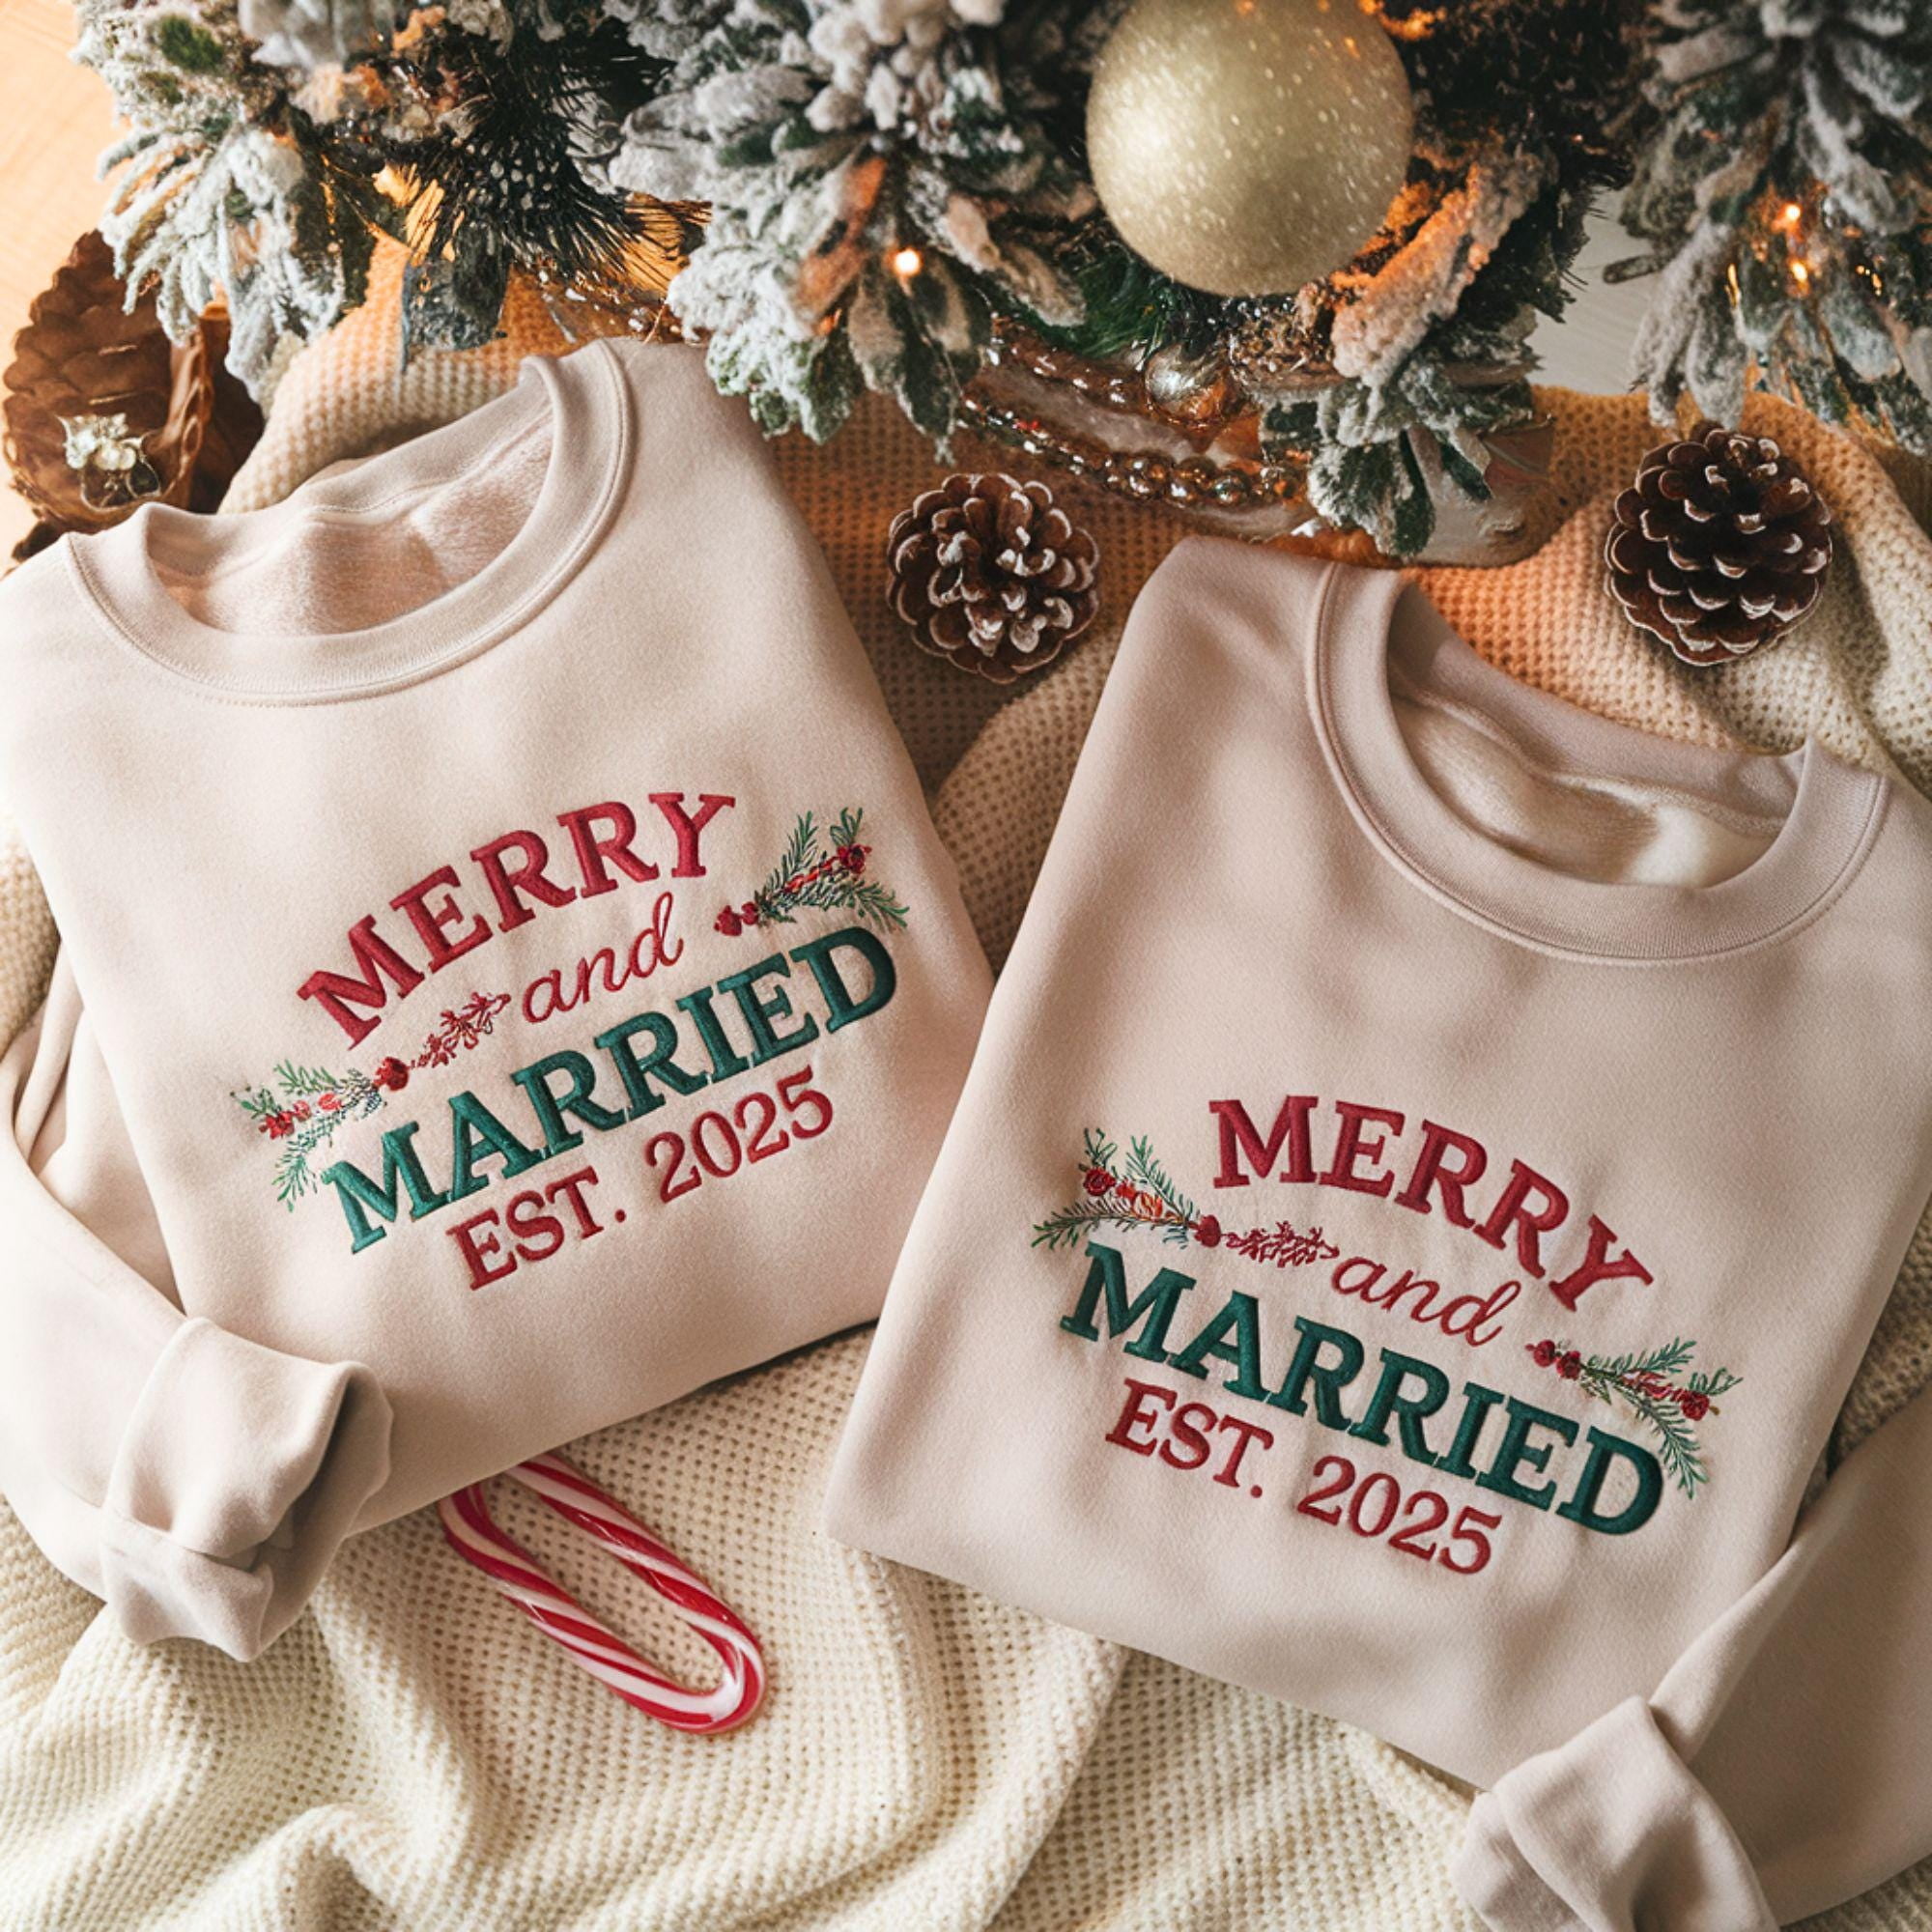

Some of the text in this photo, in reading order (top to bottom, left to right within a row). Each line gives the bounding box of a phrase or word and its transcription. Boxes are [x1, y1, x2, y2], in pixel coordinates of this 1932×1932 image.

[297, 791, 735, 1051] MERRY
[521, 891, 684, 1024] and
[321, 925, 898, 1255] MARRIED
[445, 1065, 834, 1291] EST. 2025
[1208, 1094, 1654, 1313] MERRY
[1330, 1255, 1522, 1346] and
[1059, 1242, 1663, 1536] MARRIED
[1104, 1377, 1502, 1575] EST. 2025
